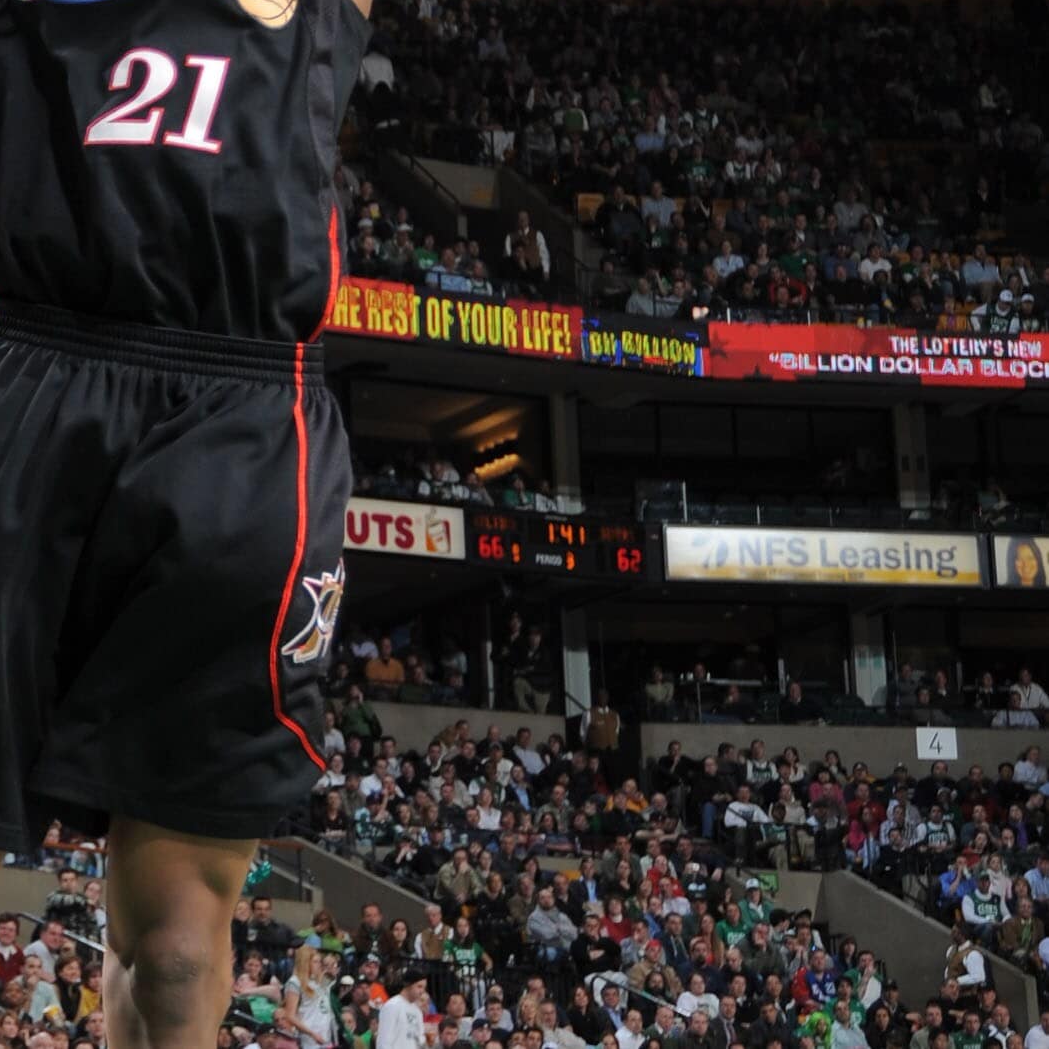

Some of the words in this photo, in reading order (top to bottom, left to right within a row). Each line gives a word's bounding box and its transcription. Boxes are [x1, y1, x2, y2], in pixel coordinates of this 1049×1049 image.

[84, 47, 231, 154] 21
[326, 285, 363, 329] HE
[365, 288, 422, 337] REST
[426, 296, 454, 341] OF
[457, 300, 518, 349] YOUR
[522, 308, 572, 354] LIFE!
[889, 335, 919, 355] THE
[925, 336, 1004, 357] LOTTERY'S
[1007, 339, 1042, 359] NEW
[879, 355, 974, 376] DOLLAR
[478, 533, 504, 560] 66
[616, 547, 642, 572] 62
[738, 535, 809, 568] NFS
[818, 538, 958, 578] Leasing
[929, 731, 943, 755] 4
